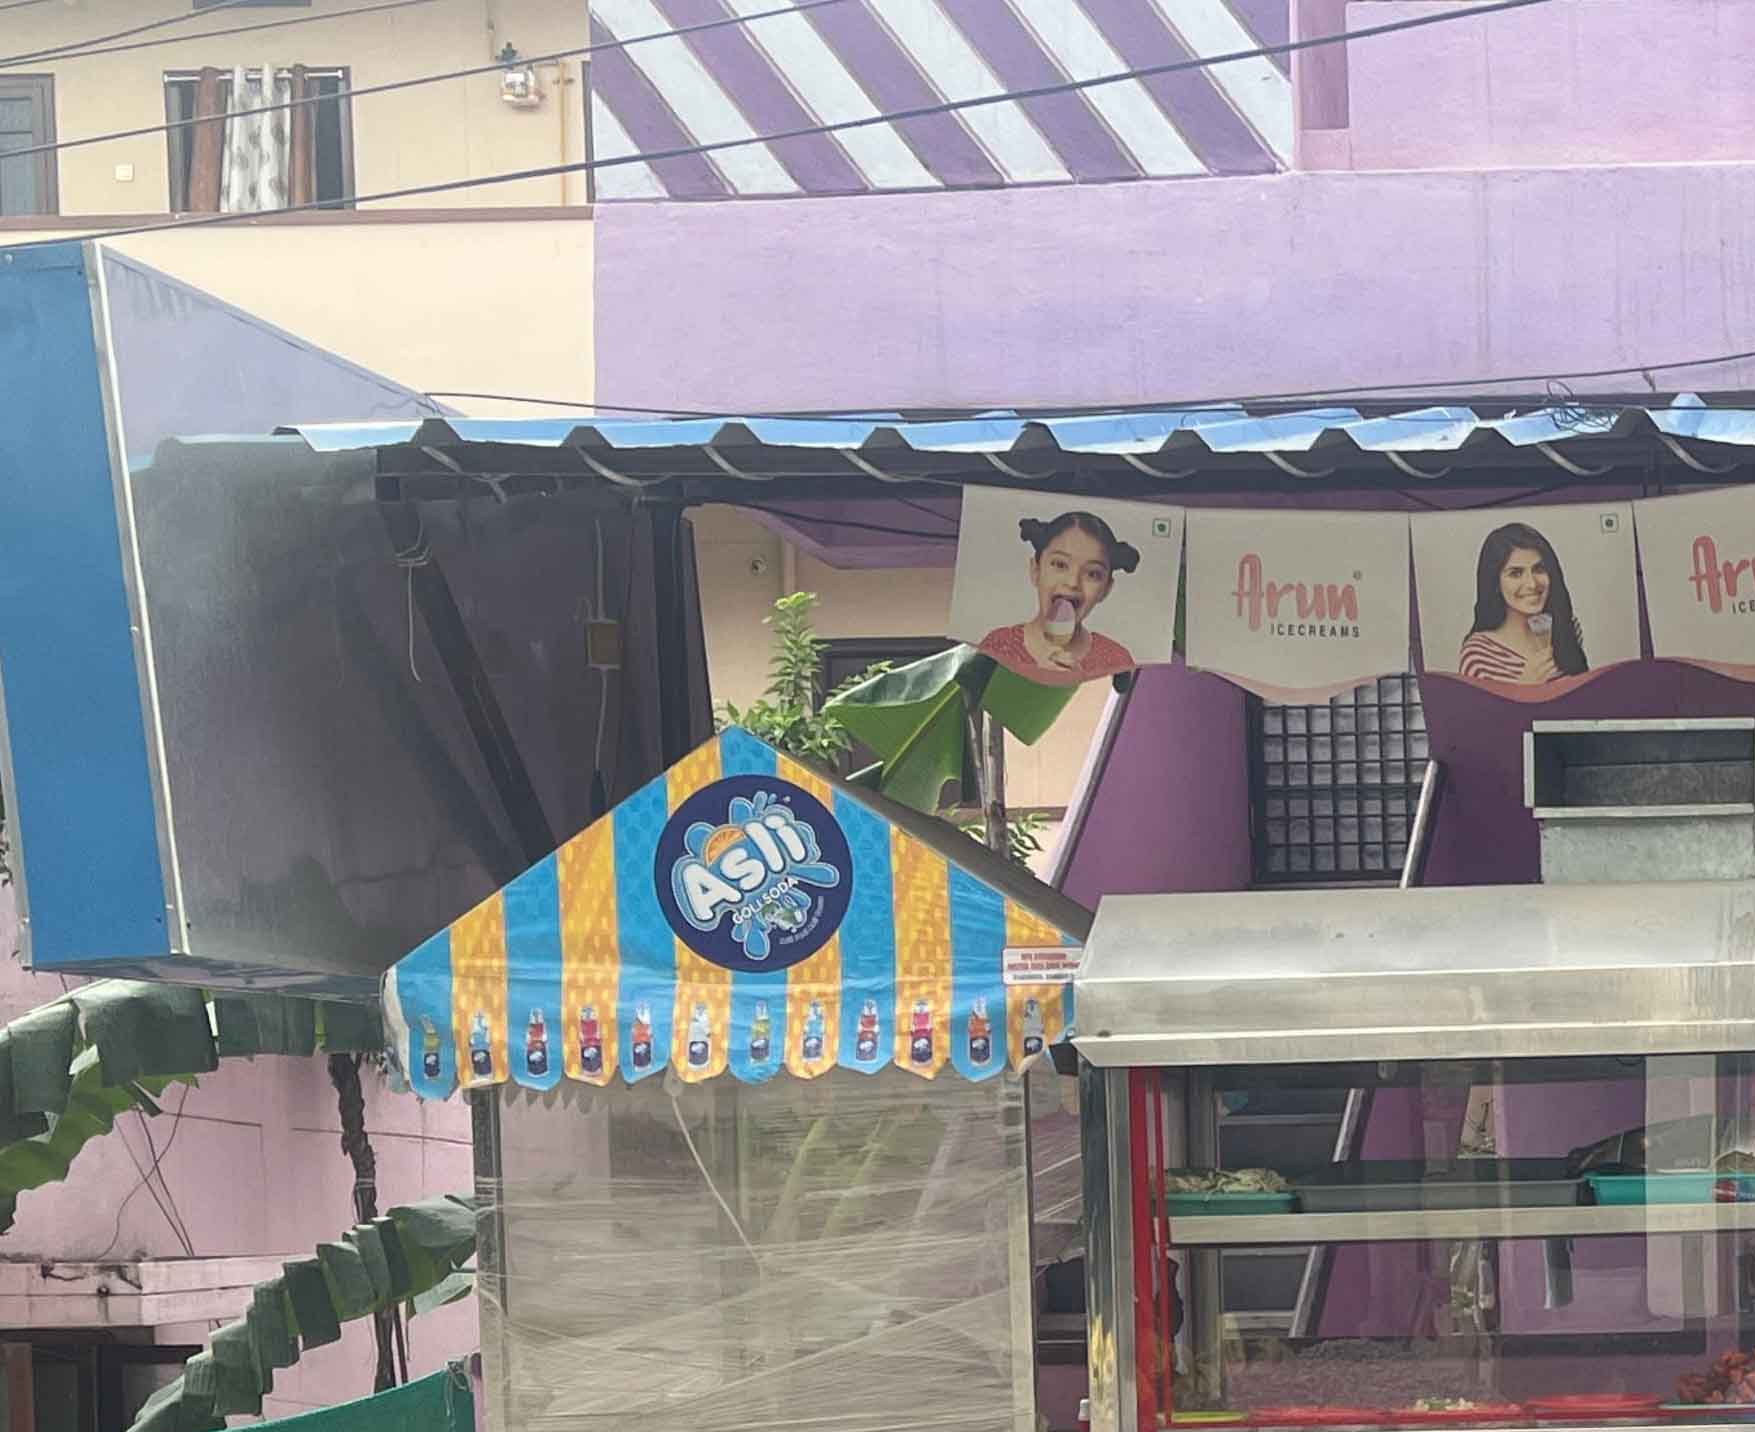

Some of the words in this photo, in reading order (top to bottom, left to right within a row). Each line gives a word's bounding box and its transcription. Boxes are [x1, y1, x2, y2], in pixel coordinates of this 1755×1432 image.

[1232, 553, 1358, 631] Arun
[1269, 623, 1360, 638] ICECREAMS
[764, 876, 799, 904] SODA
